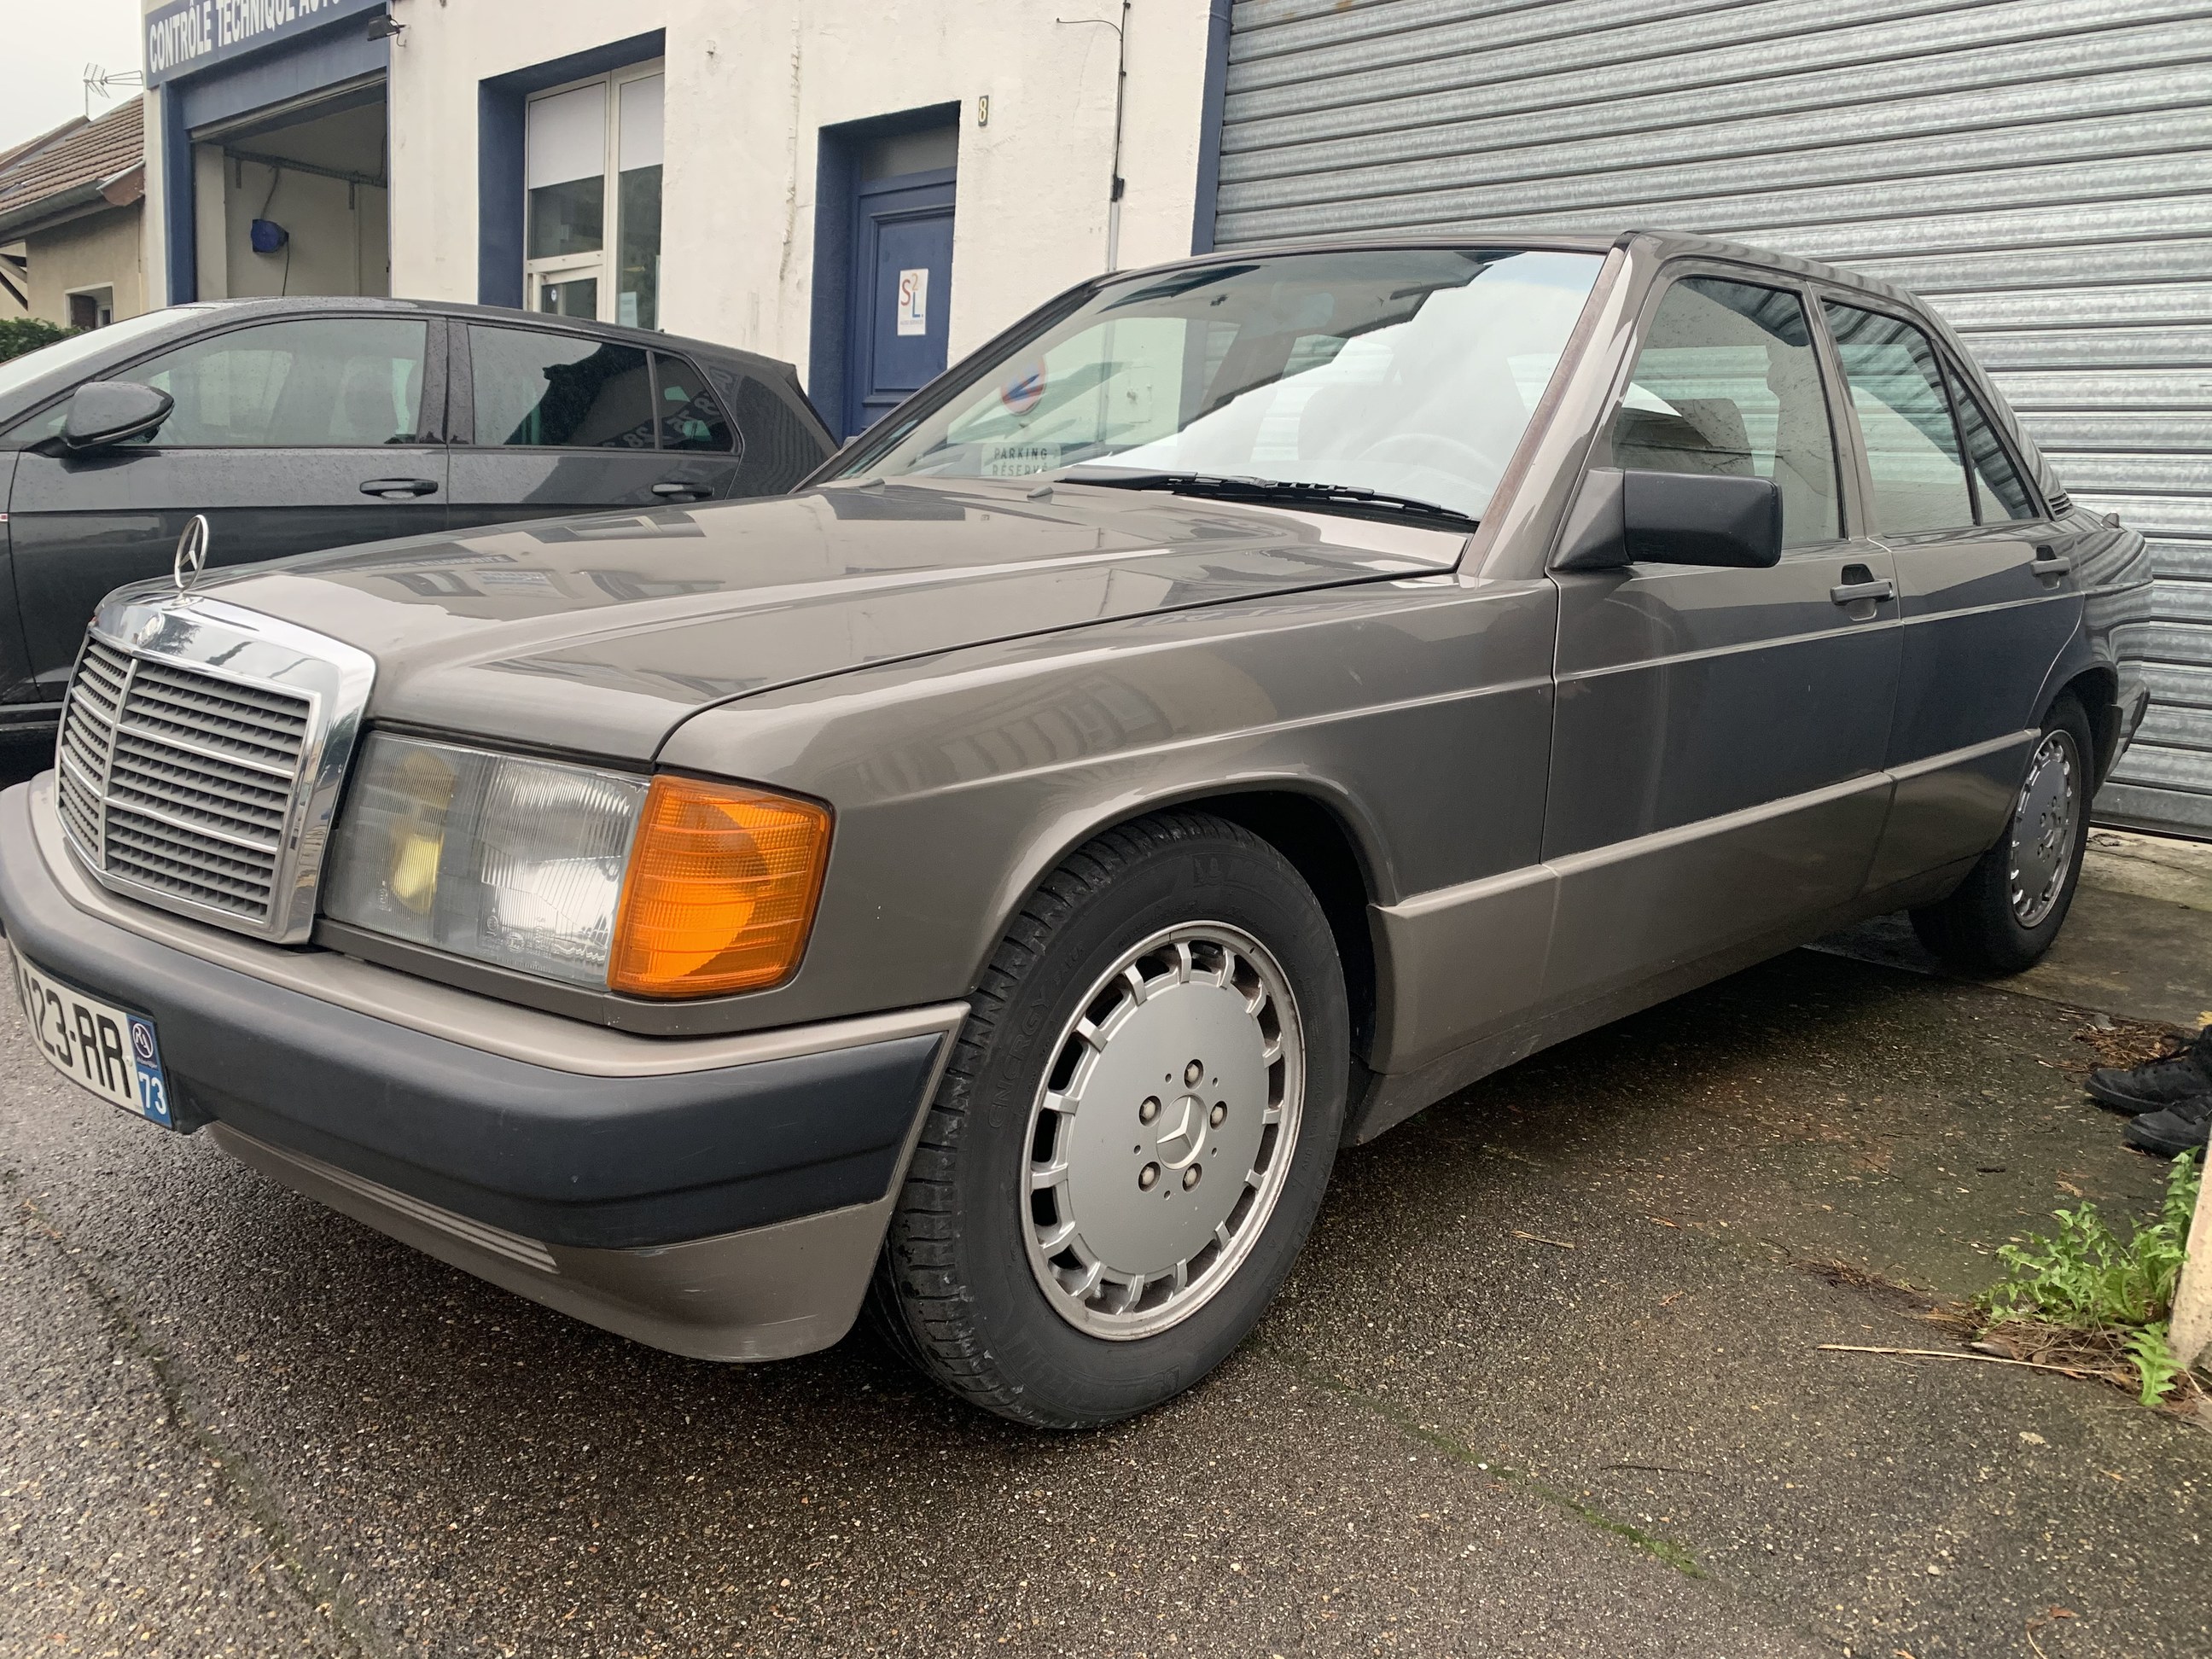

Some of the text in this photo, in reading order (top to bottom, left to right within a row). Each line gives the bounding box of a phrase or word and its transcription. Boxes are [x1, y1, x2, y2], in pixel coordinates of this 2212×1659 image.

[148, 1, 212, 74] CONTRÔLE
[979, 97, 987, 123] 8
[994, 447, 1048, 460] PARKING
[138, 1071, 166, 1115] 73
